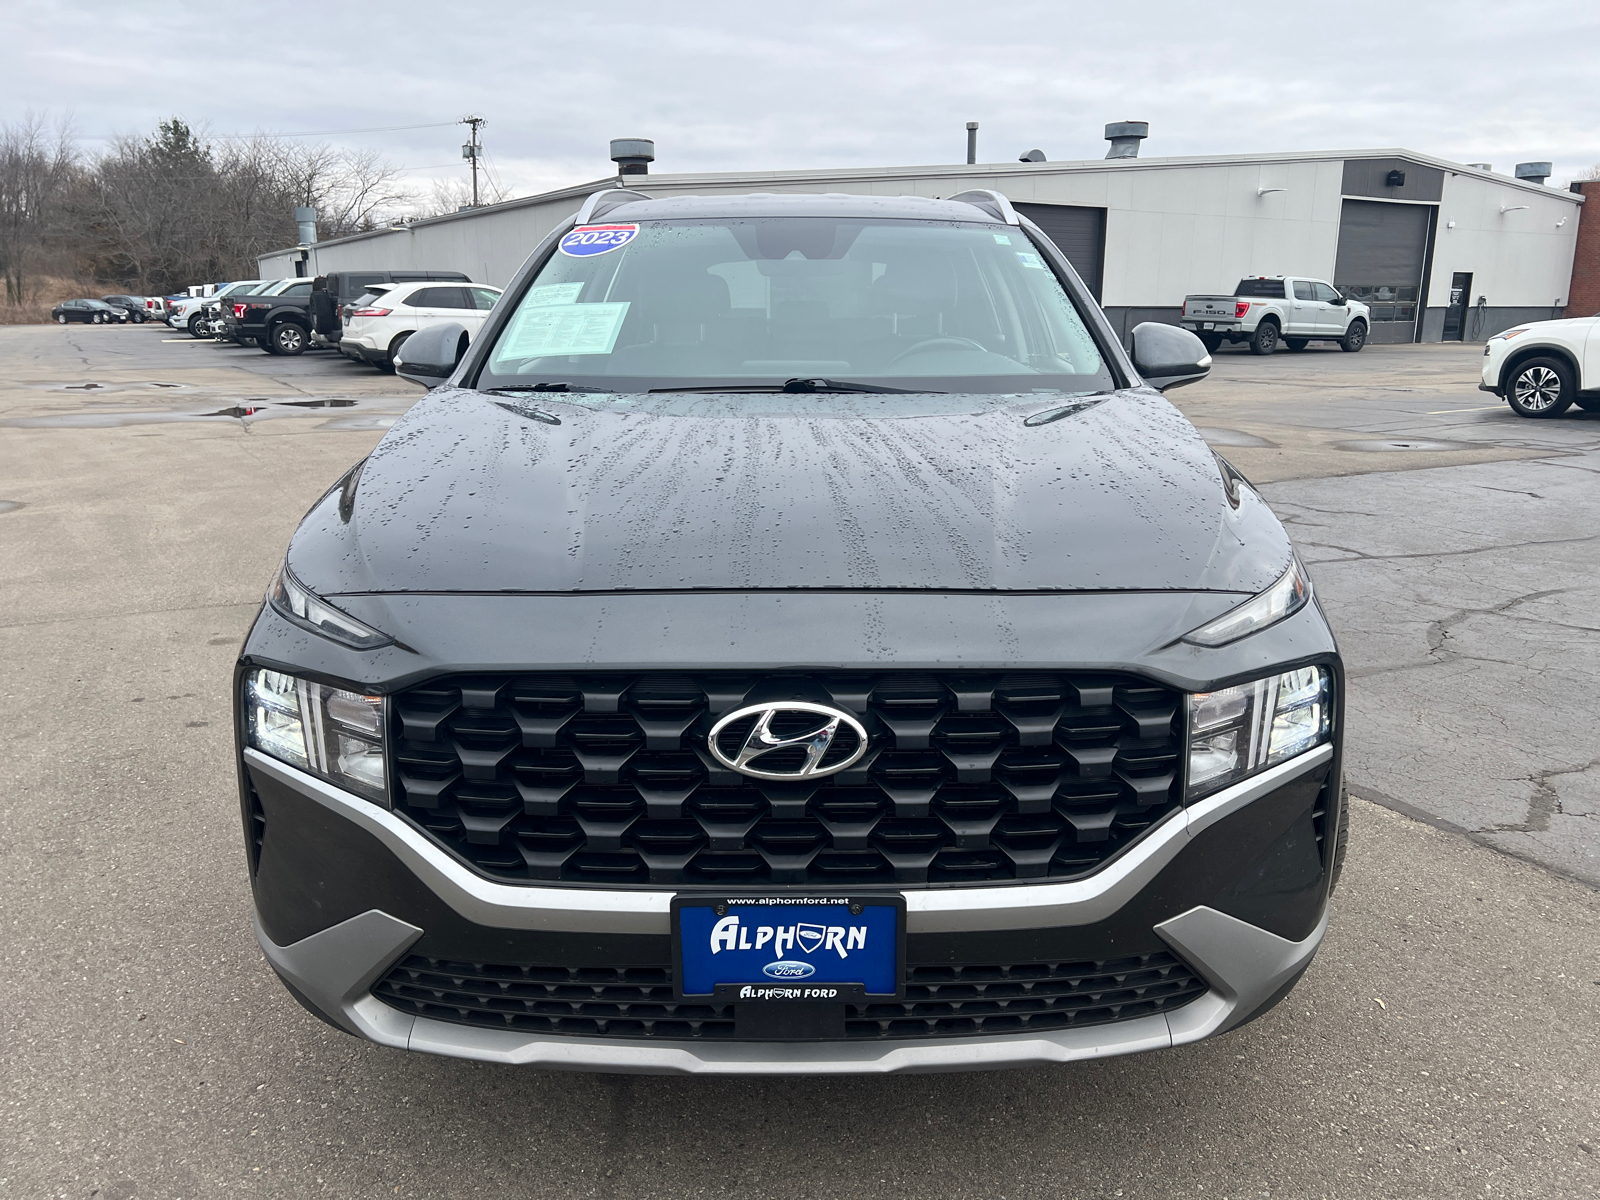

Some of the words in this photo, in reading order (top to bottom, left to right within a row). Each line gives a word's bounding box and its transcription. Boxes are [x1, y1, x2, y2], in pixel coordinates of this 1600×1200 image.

[563, 231, 630, 247] 2023
[727, 897, 849, 906] www.alphornford.net
[774, 964, 805, 976] Ford
[803, 988, 838, 999] FORD
